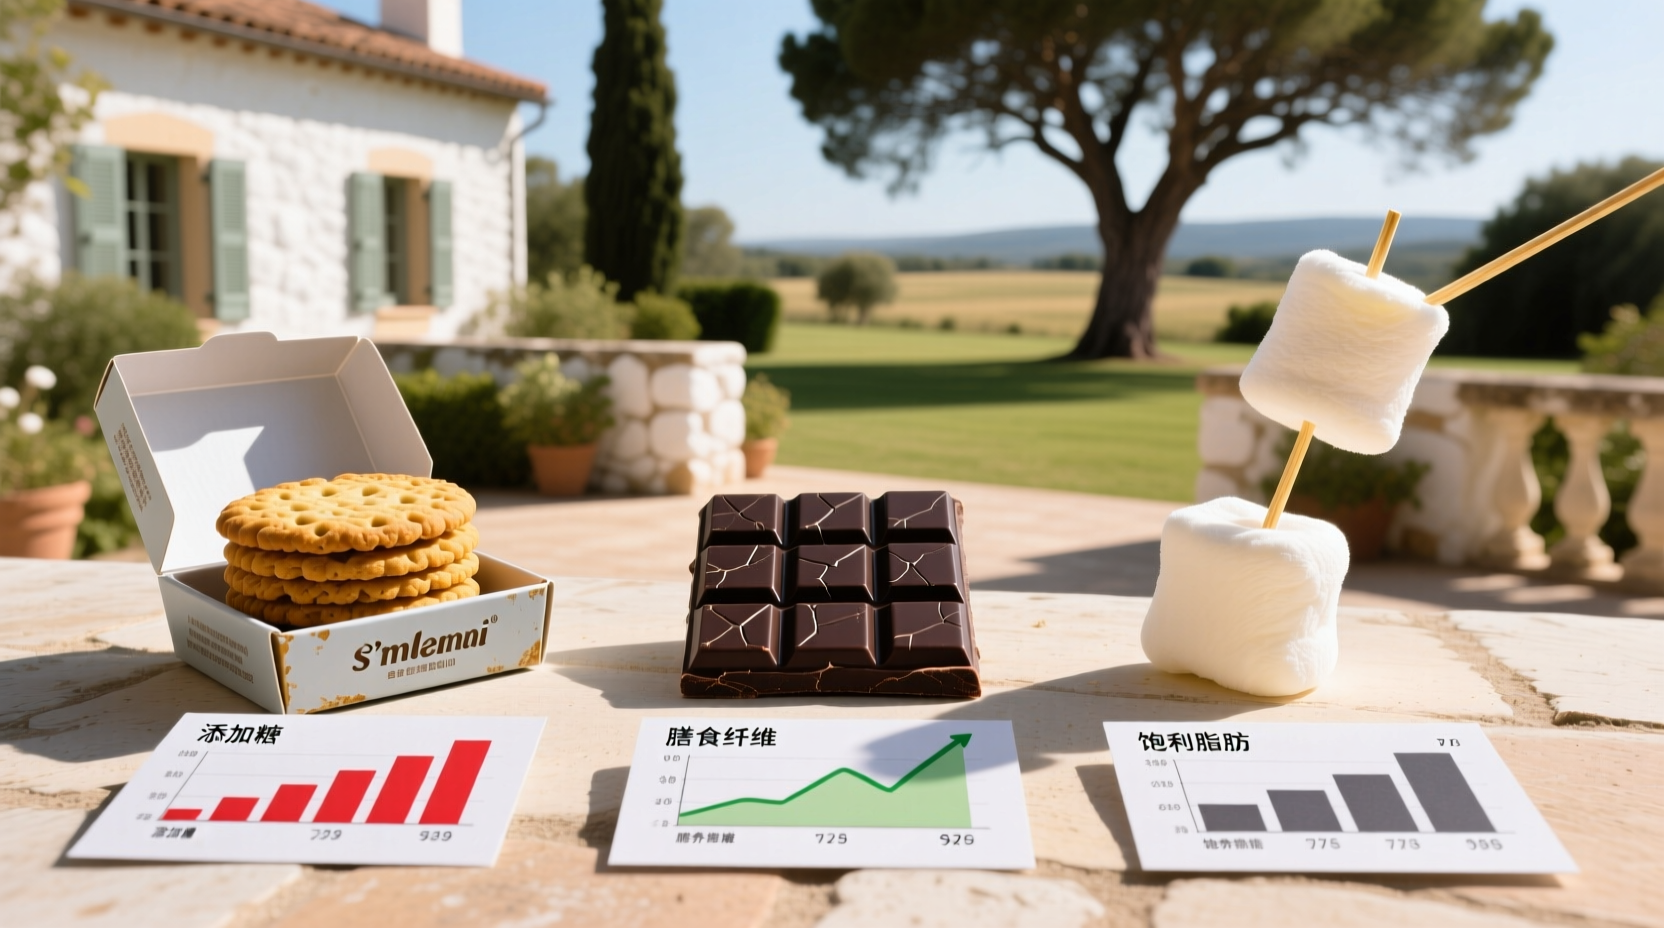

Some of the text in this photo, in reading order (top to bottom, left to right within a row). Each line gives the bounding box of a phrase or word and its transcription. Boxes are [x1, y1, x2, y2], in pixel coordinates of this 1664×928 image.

[197, 723, 284, 744] 添加糖
[666, 725, 777, 747] 膳食纤维
[1138, 731, 1250, 752] 饱利脂肪
